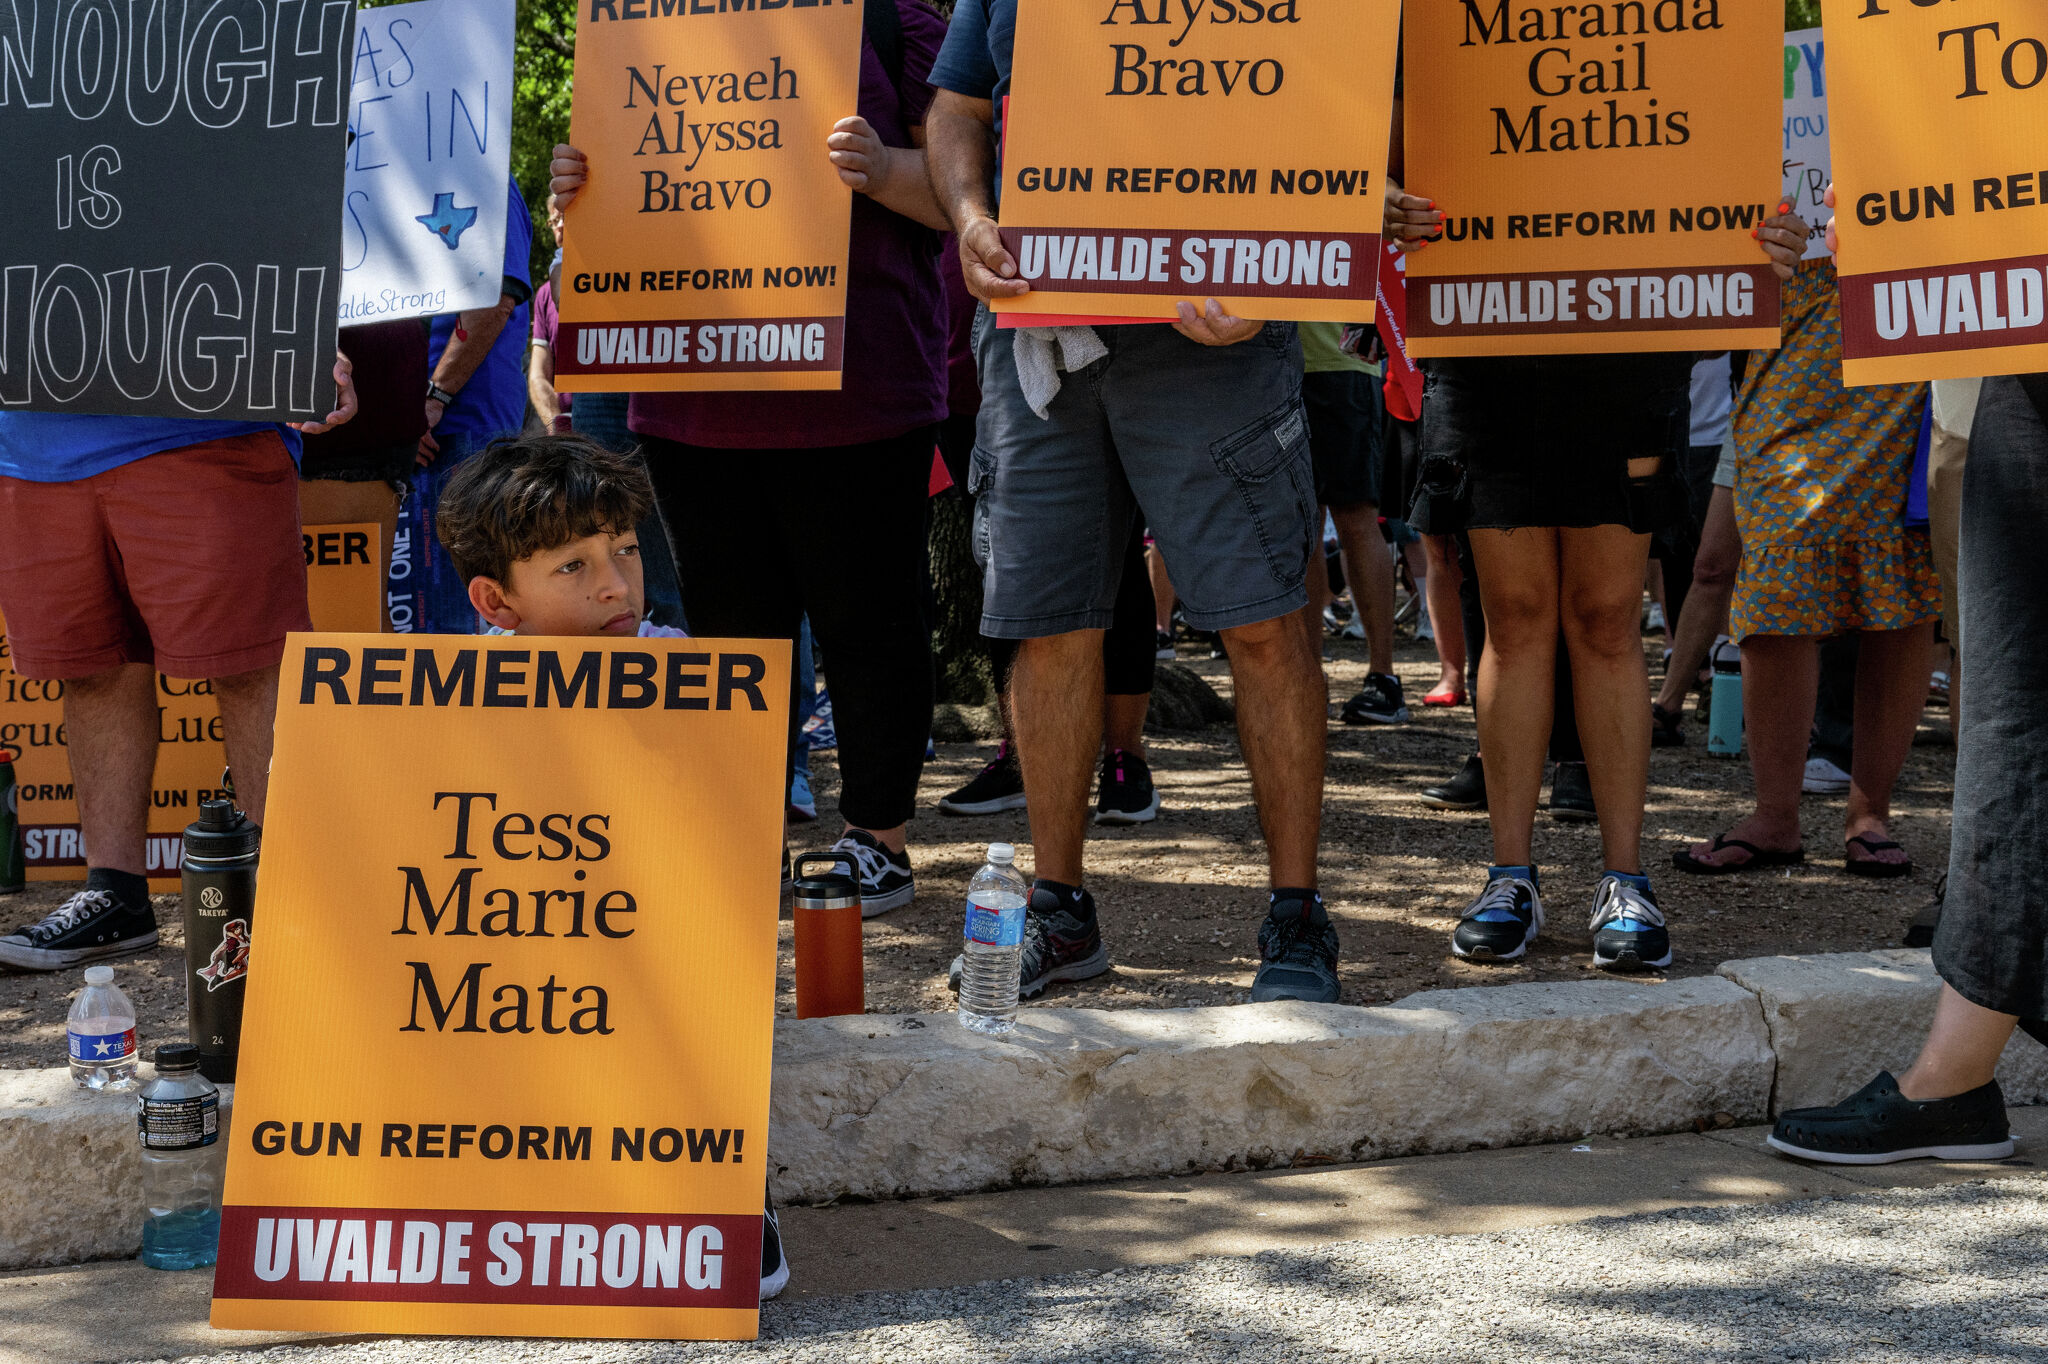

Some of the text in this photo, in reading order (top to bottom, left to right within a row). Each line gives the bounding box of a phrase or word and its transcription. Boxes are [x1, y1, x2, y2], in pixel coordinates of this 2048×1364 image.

[591, 0, 852, 22] REME
[1460, 0, 1724, 46] Maranda
[624, 57, 799, 108] Nevaeh
[1105, 43, 1284, 96] Bravo
[1528, 41, 1651, 97] Gail
[1938, 22, 2048, 99] To
[426, 80, 489, 162] IN
[634, 111, 783, 171] Alyssa
[1489, 99, 1690, 155] Mathis
[57, 145, 122, 230] IS
[639, 171, 771, 213] Bravo
[1017, 167, 1369, 196] GUN REFORM NOW!
[1856, 183, 1955, 226] GUN
[1421, 204, 1765, 242] UN REFORM NOW!
[573, 266, 837, 293] GUN REFORM NOW!
[1019, 235, 1171, 285] UVALDE
[1180, 238, 1352, 287] STRONG
[1430, 272, 1754, 326] UVALDE STRONG
[1873, 265, 2048, 340] UVALD
[577, 323, 824, 365] UVALDE STRONG
[389, 527, 411, 580] ONE
[0, 668, 65, 702] ico
[299, 647, 769, 712] REMEMBER
[17, 784, 74, 801] ORM
[149, 789, 188, 808] UN
[433, 792, 611, 862] Tess
[391, 866, 637, 939] Marie
[970, 921, 1001, 936] SPRING
[399, 961, 615, 1035] Mata
[113, 1040, 132, 1050] TEXAS
[212, 1035, 224, 1045] 24
[251, 1120, 745, 1164] GUN REFORM NOW!
[253, 1217, 724, 1290] UVALDE STRONG
